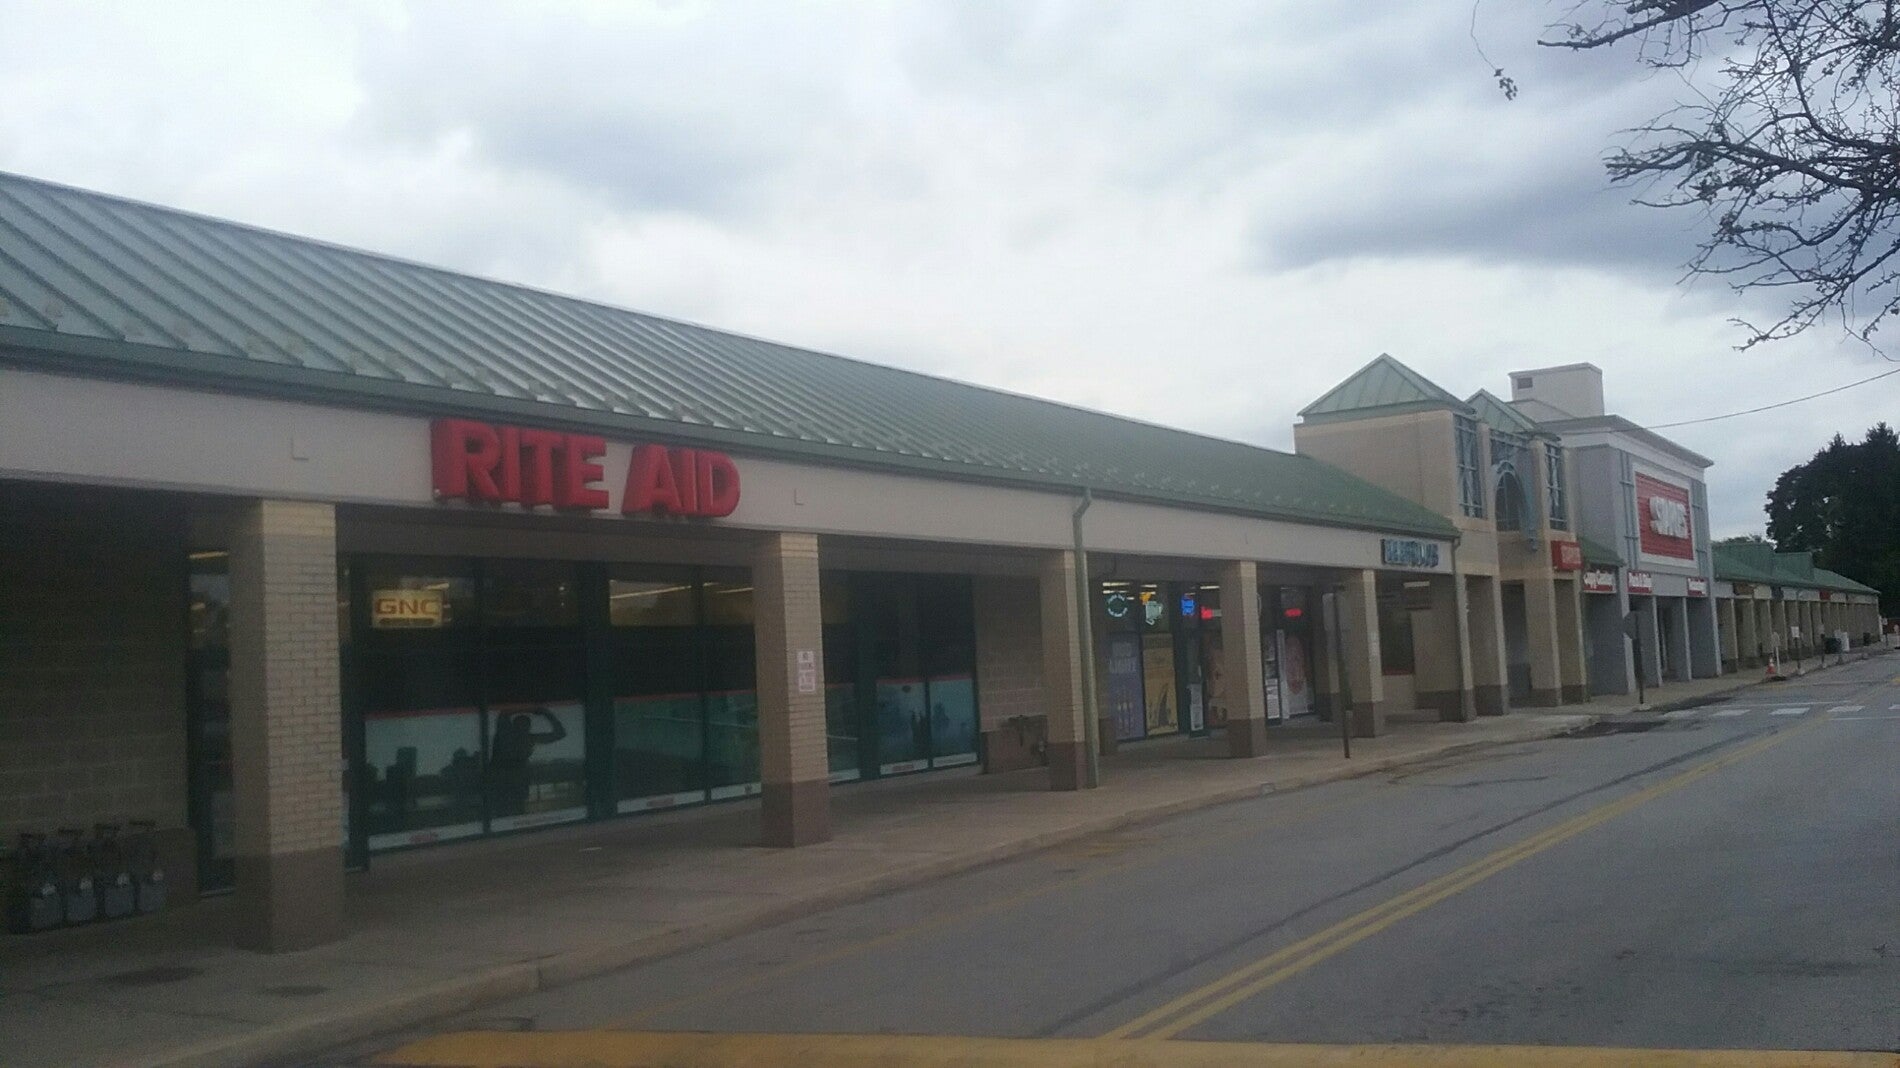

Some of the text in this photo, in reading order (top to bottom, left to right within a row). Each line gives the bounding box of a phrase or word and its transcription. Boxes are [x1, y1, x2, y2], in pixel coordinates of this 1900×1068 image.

[431, 417, 741, 518] RITE AID
[375, 598, 441, 615] GNC
